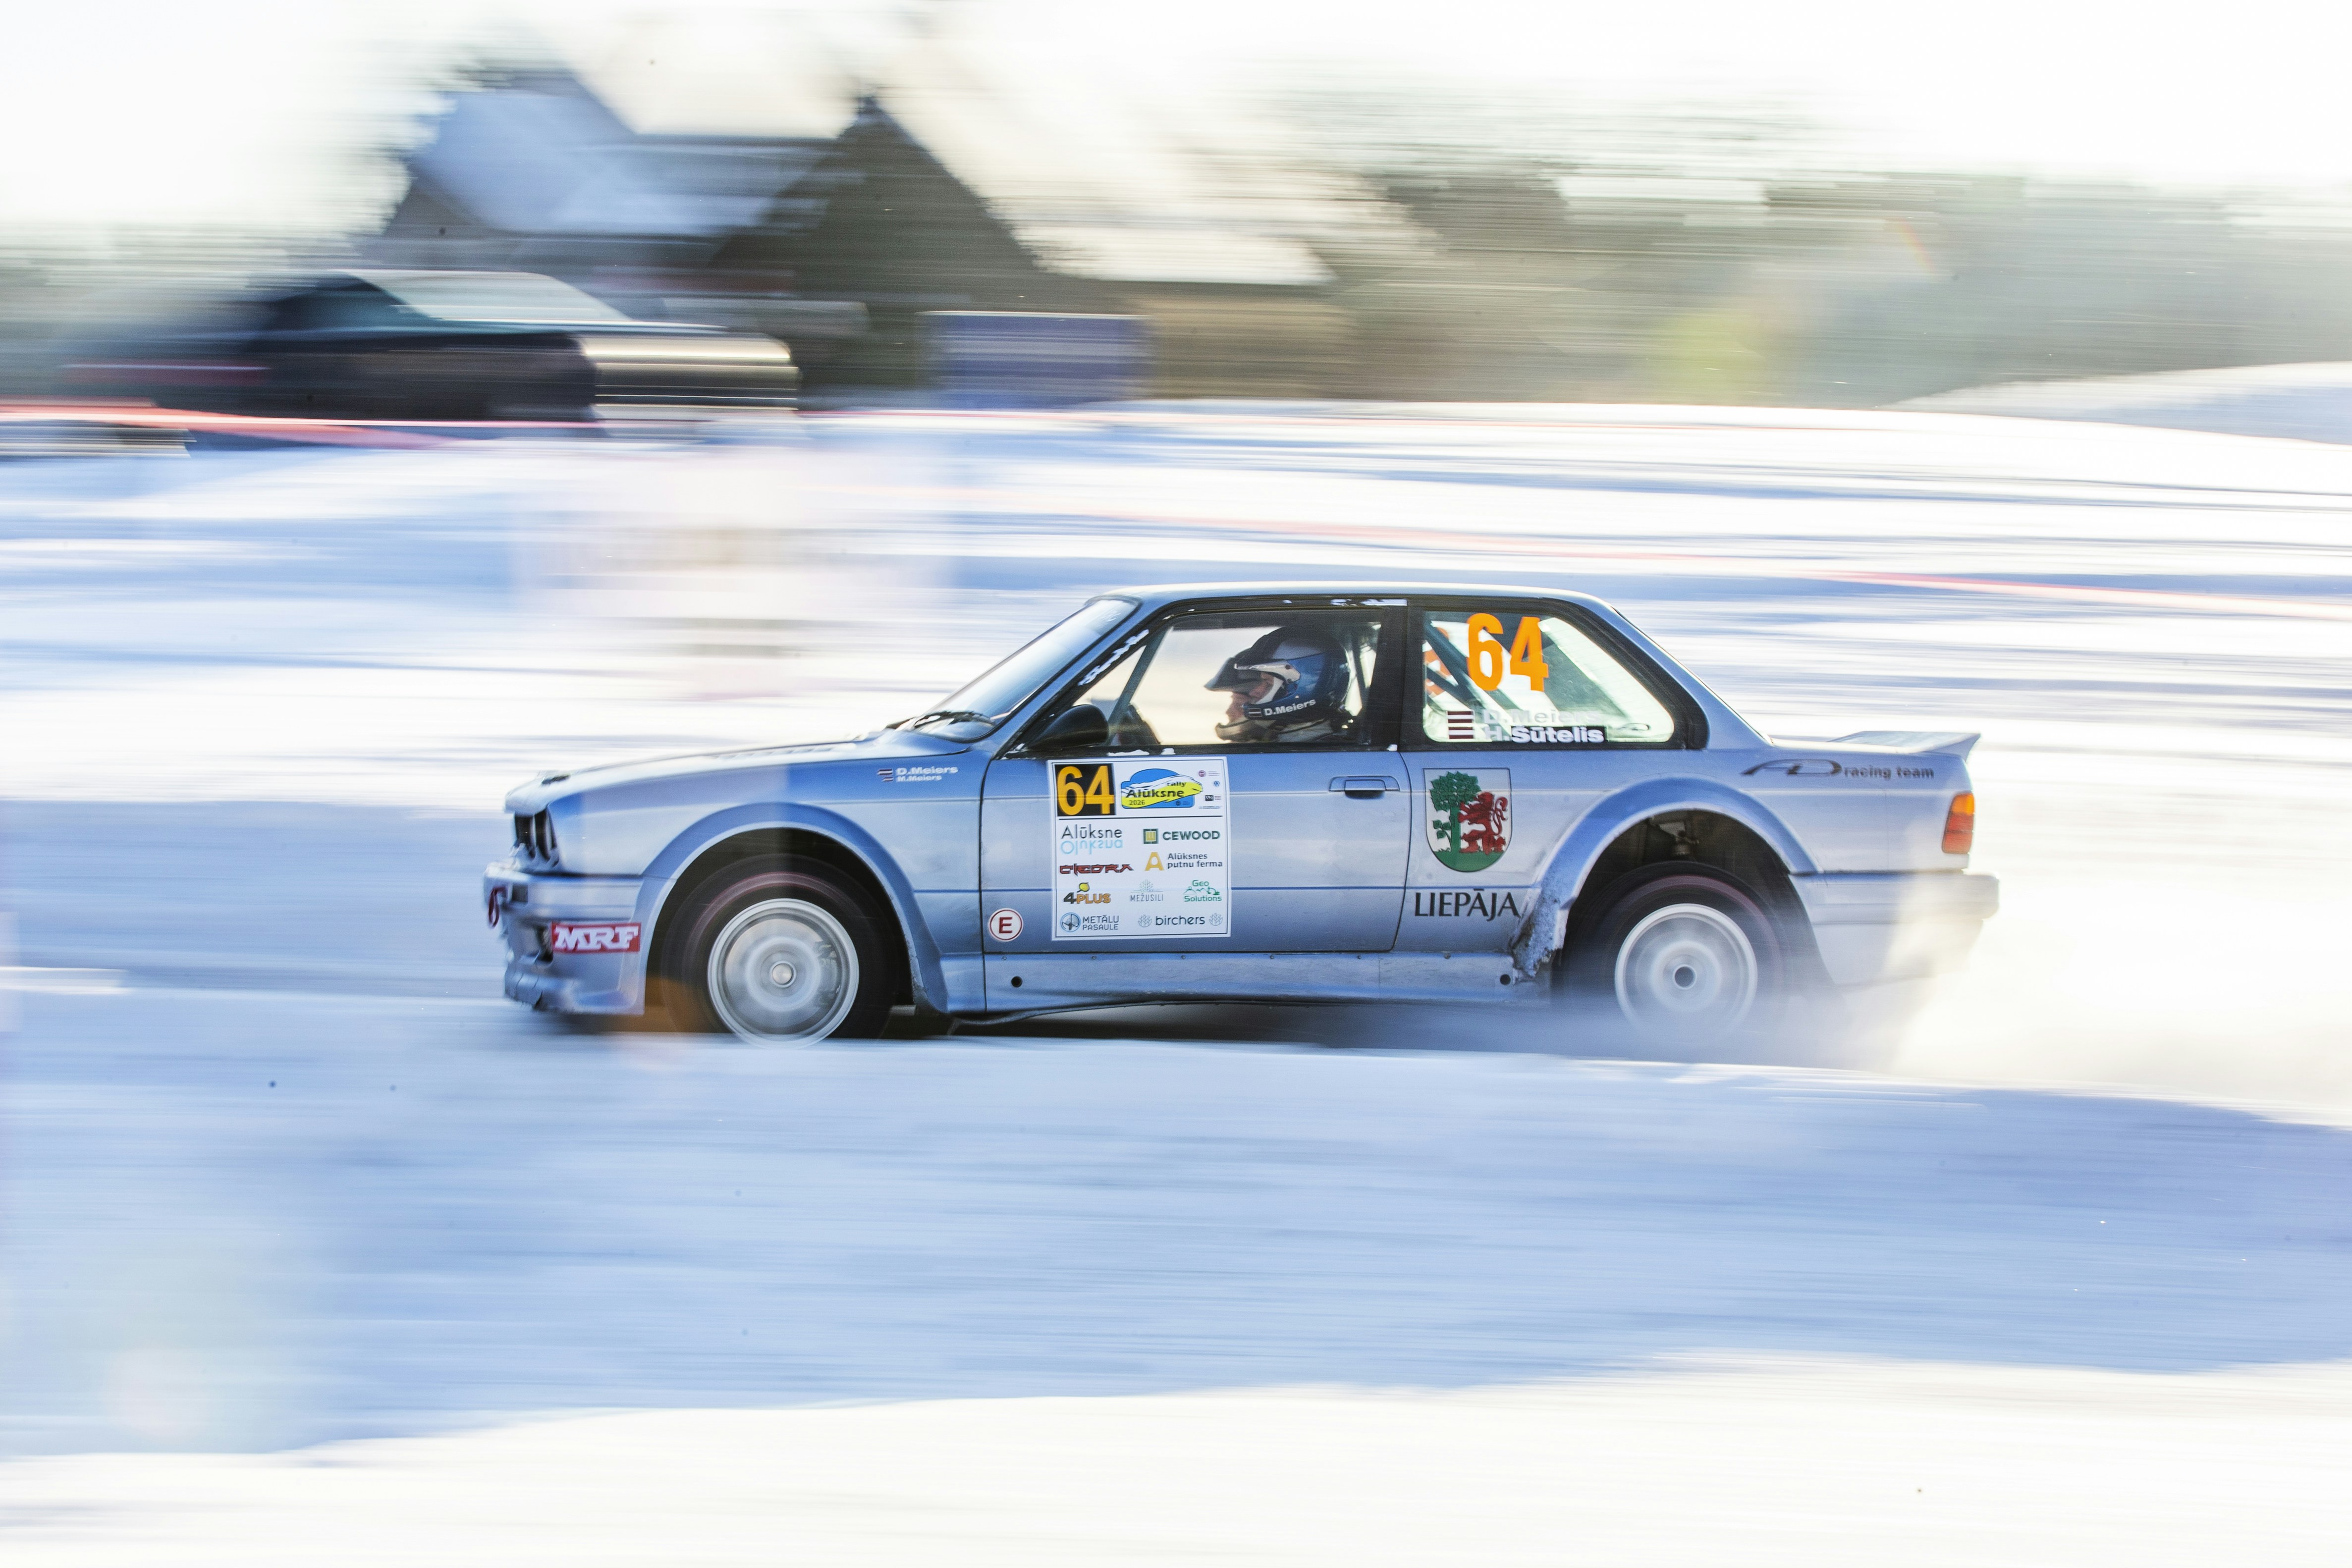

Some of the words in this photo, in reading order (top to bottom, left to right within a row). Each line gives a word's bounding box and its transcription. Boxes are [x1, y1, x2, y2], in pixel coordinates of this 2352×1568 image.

[1467, 612, 1549, 692] 64
[1264, 699, 1316, 716] D.Meiers
[896, 766, 958, 775] D.Meiers
[1844, 765, 1892, 779] racing
[1897, 765, 1934, 778] team
[1057, 765, 1115, 815] 64
[1126, 789, 1184, 798] Alūksne
[1061, 824, 1122, 839] Alūksne
[1162, 831, 1220, 840] CEWOOD
[1130, 893, 1163, 902] MEŽUSILI
[1415, 888, 1521, 921] LIEPĀJA
[999, 917, 1013, 933] E
[1083, 915, 1119, 923] METĀLU
[1155, 916, 1205, 925] birchers
[554, 924, 639, 952] MRF
